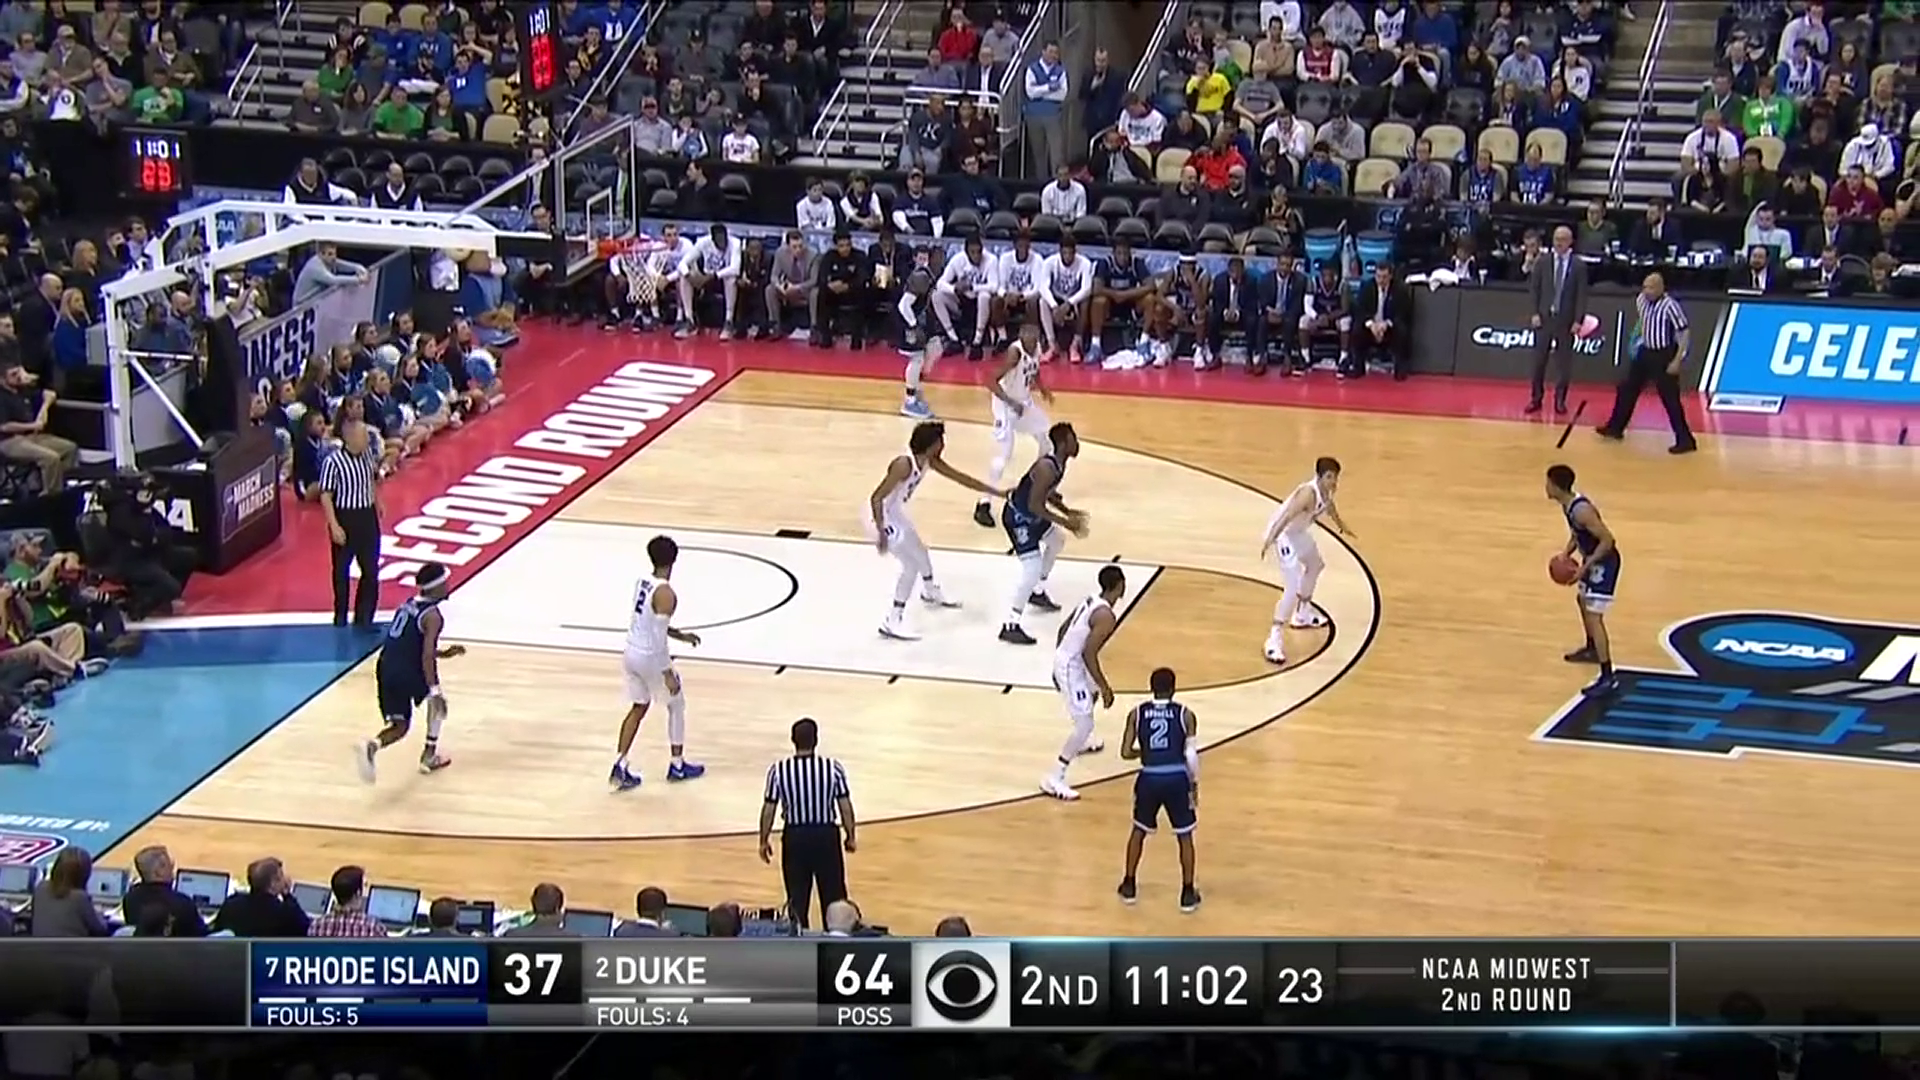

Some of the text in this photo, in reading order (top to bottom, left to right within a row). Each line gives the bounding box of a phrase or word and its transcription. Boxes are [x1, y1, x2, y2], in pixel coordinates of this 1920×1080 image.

[135, 139, 180, 159] 11:01
[243, 308, 316, 380] NESS
[233, 472, 261, 505] MARCH
[349, 361, 716, 587] SECOND ROUND
[237, 482, 275, 521] MADNESS
[1713, 638, 1847, 662] NCAA
[1149, 719, 1168, 749] 2
